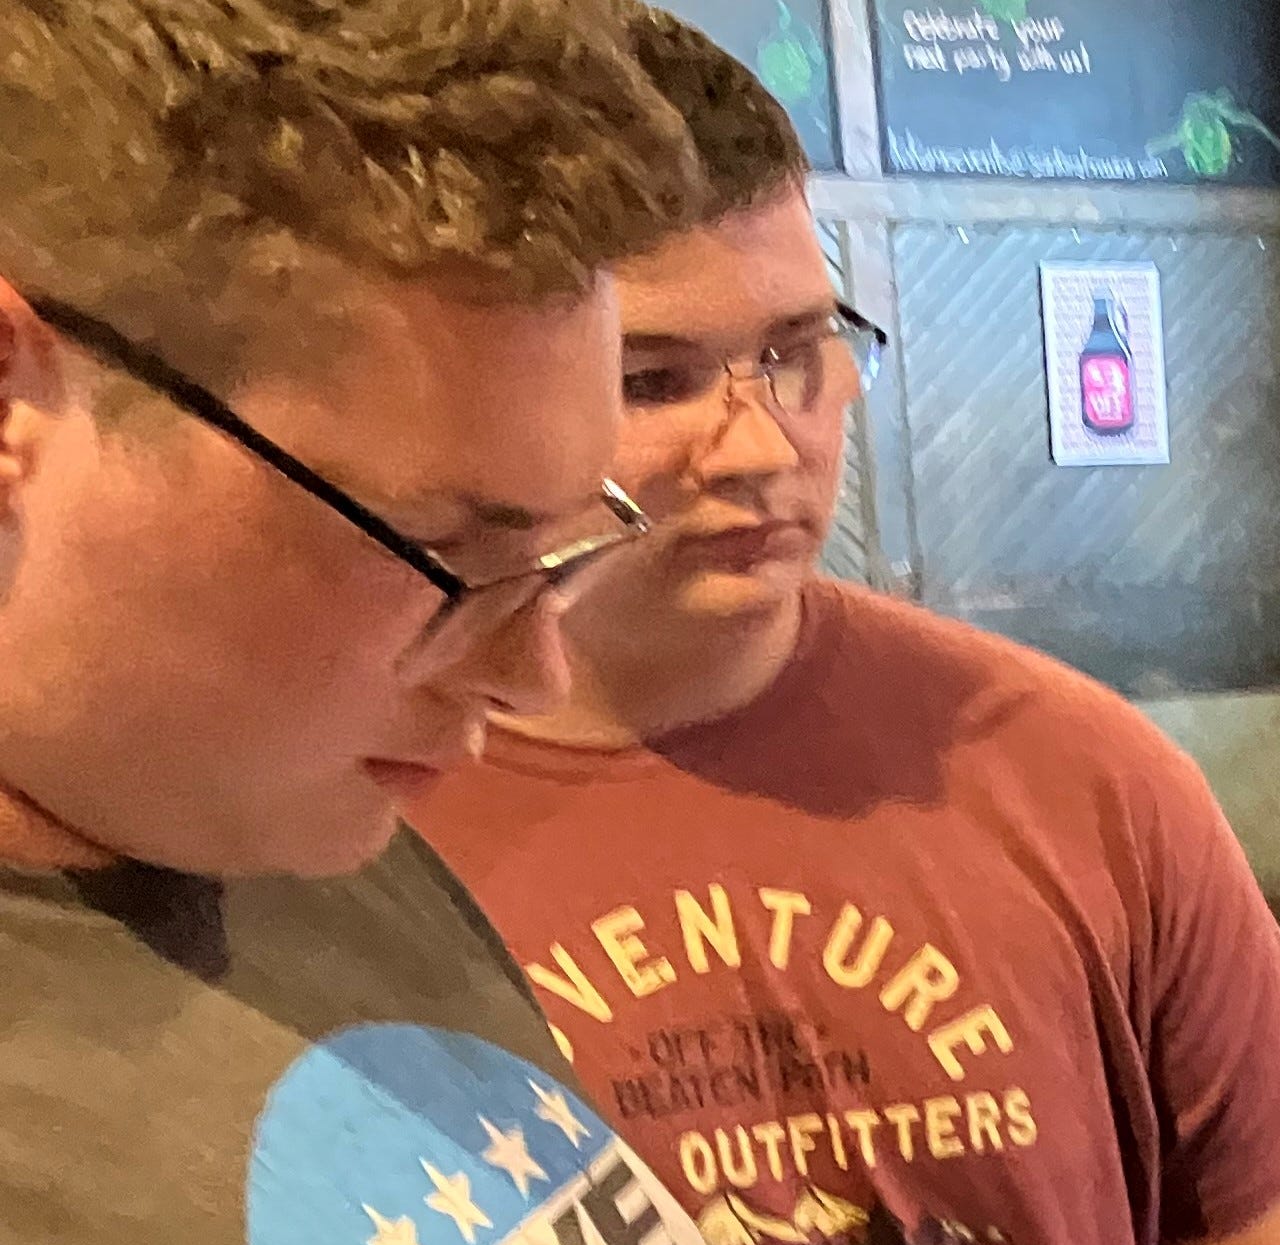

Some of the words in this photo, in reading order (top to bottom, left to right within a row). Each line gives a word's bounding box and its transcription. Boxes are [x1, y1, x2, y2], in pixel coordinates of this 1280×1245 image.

[953, 43, 1011, 82] party
[1010, 16, 1065, 48] your
[524, 881, 1014, 1081] VENTURE
[679, 1085, 1037, 1195] OUTFITTERS
